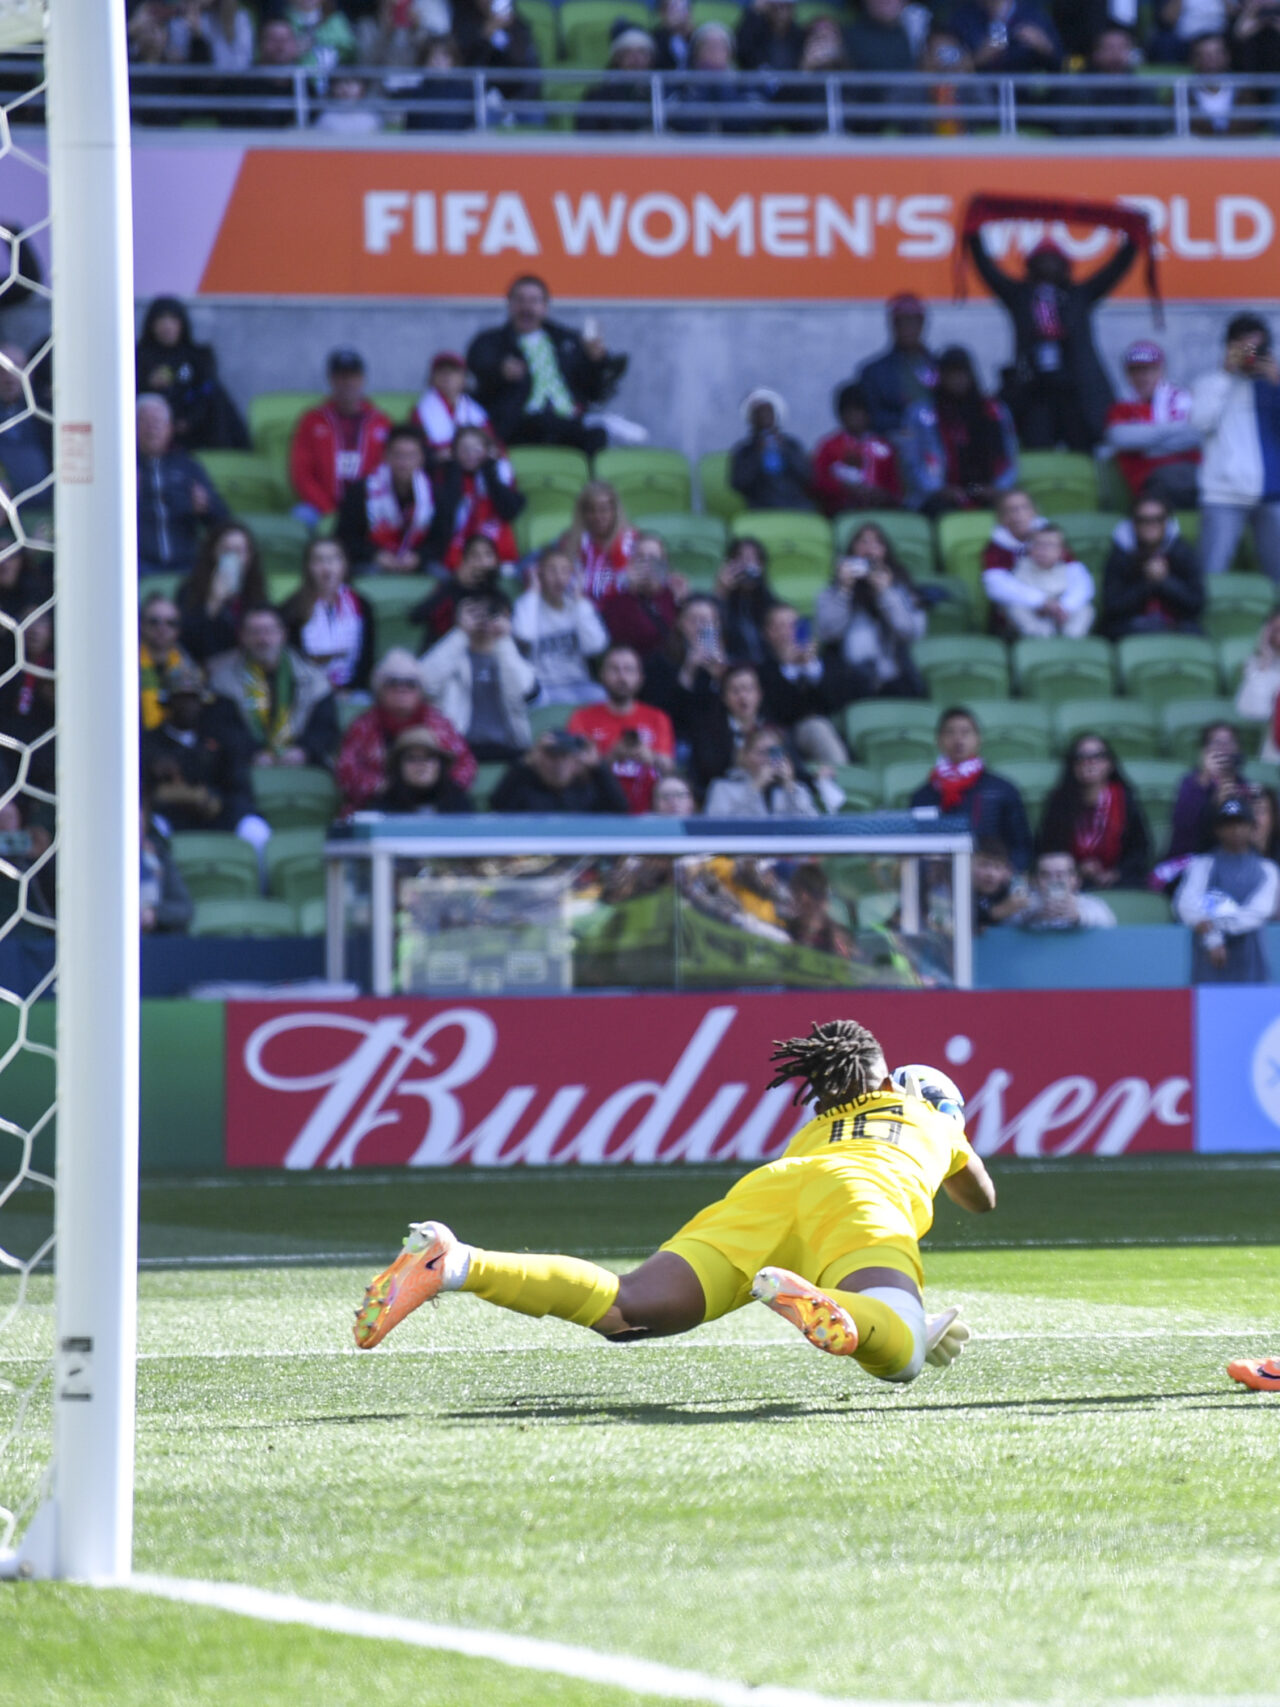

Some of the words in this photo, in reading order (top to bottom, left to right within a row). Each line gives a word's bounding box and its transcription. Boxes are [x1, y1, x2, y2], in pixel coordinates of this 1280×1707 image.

[364, 190, 540, 254] FIFA
[553, 192, 956, 258] WOMEN'S
[830, 1104, 904, 1145] 16
